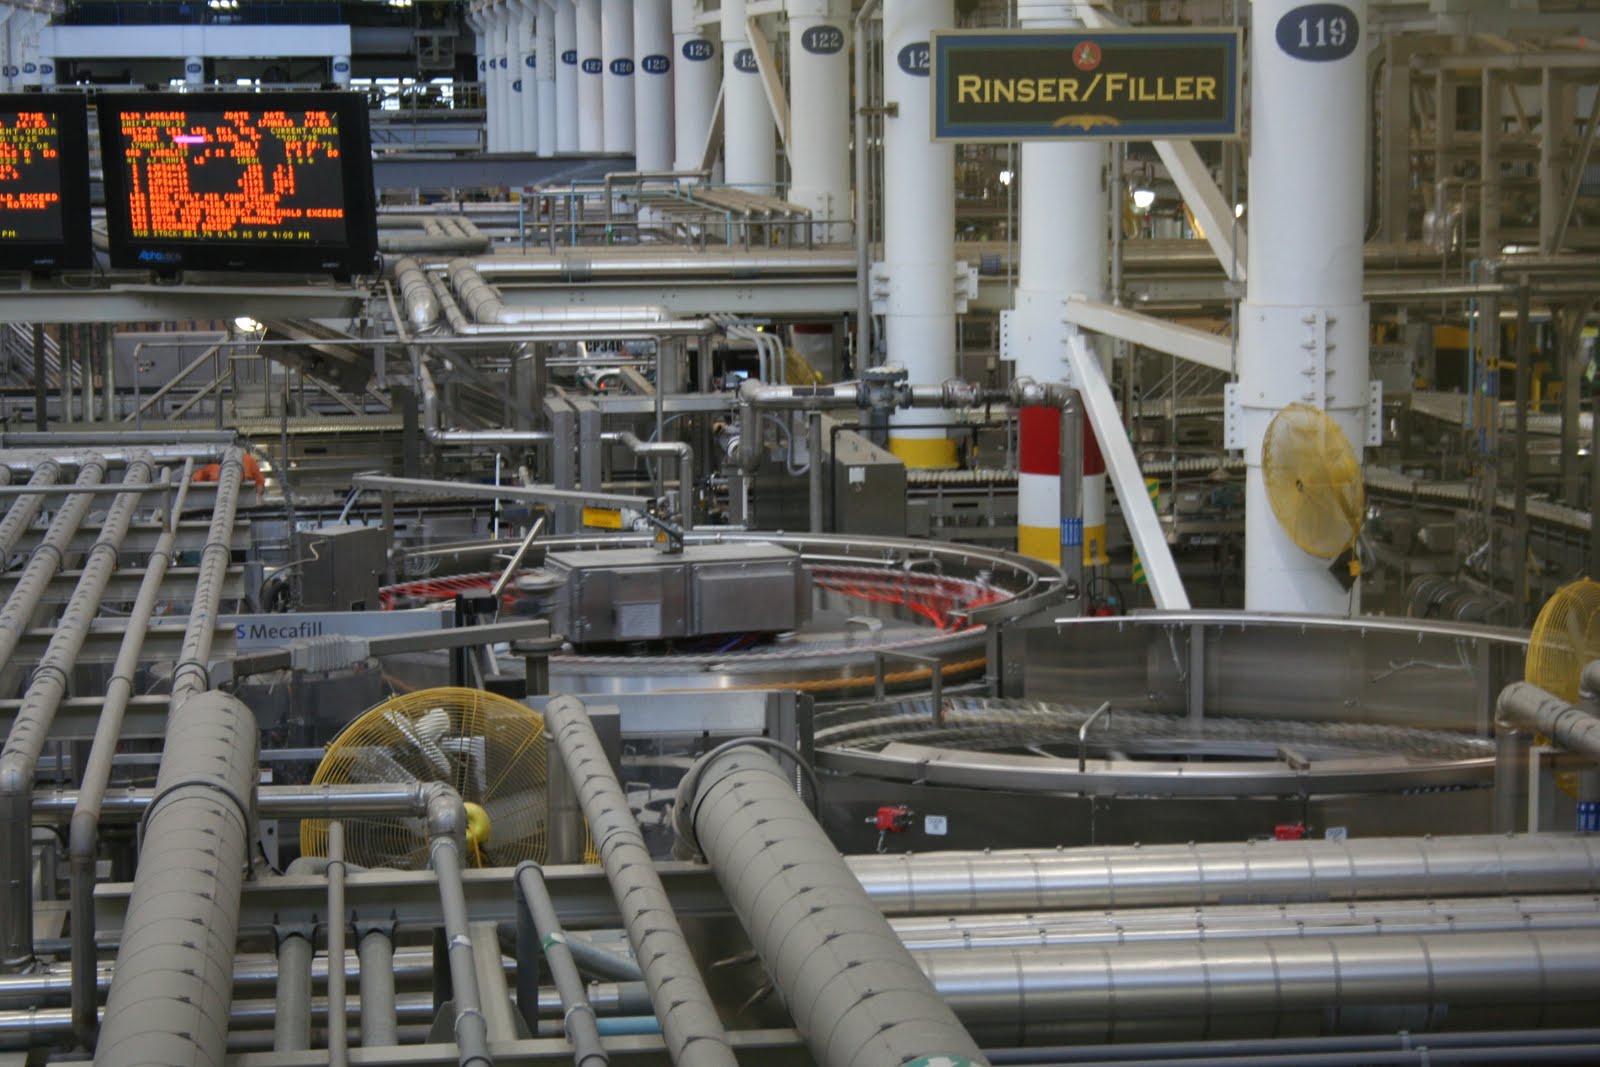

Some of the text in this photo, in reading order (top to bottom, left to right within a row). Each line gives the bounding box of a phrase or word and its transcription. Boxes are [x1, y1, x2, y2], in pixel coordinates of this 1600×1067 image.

[1299, 17, 1347, 47] 119
[811, 32, 840, 48] 122
[688, 45, 710, 57] 124
[565, 53, 577, 61] 12
[740, 54, 756, 68] 12
[908, 50, 930, 69] 12
[647, 59, 666, 70] 125
[18, 112, 44, 120] TIME
[145, 112, 185, 120] LABELERS
[263, 111, 285, 120] DATE
[305, 111, 327, 119] TIME
[121, 119, 146, 127] SHIFT
[270, 127, 338, 135] CURRENT ORDER
[218, 134, 238, 142] 100%
[19, 193, 59, 202] EXCEED
[223, 192, 280, 202] CONDITIONER
[7, 200, 46, 209] ROTATE
[185, 200, 225, 208] LABELING
[245, 201, 275, 209] ACTIVE
[205, 208, 251, 216] FREQUENCY
[256, 208, 302, 217] THRESHOLD
[205, 216, 237, 224] CLOSED
[241, 216, 283, 224] MANUALLY
[152, 222, 197, 230] DISCHARGE
[202, 223, 232, 231] BACKUP
[257, 231, 268, 239] OF
[298, 232, 310, 240] PM
[250, 621, 322, 640] Mecafill
